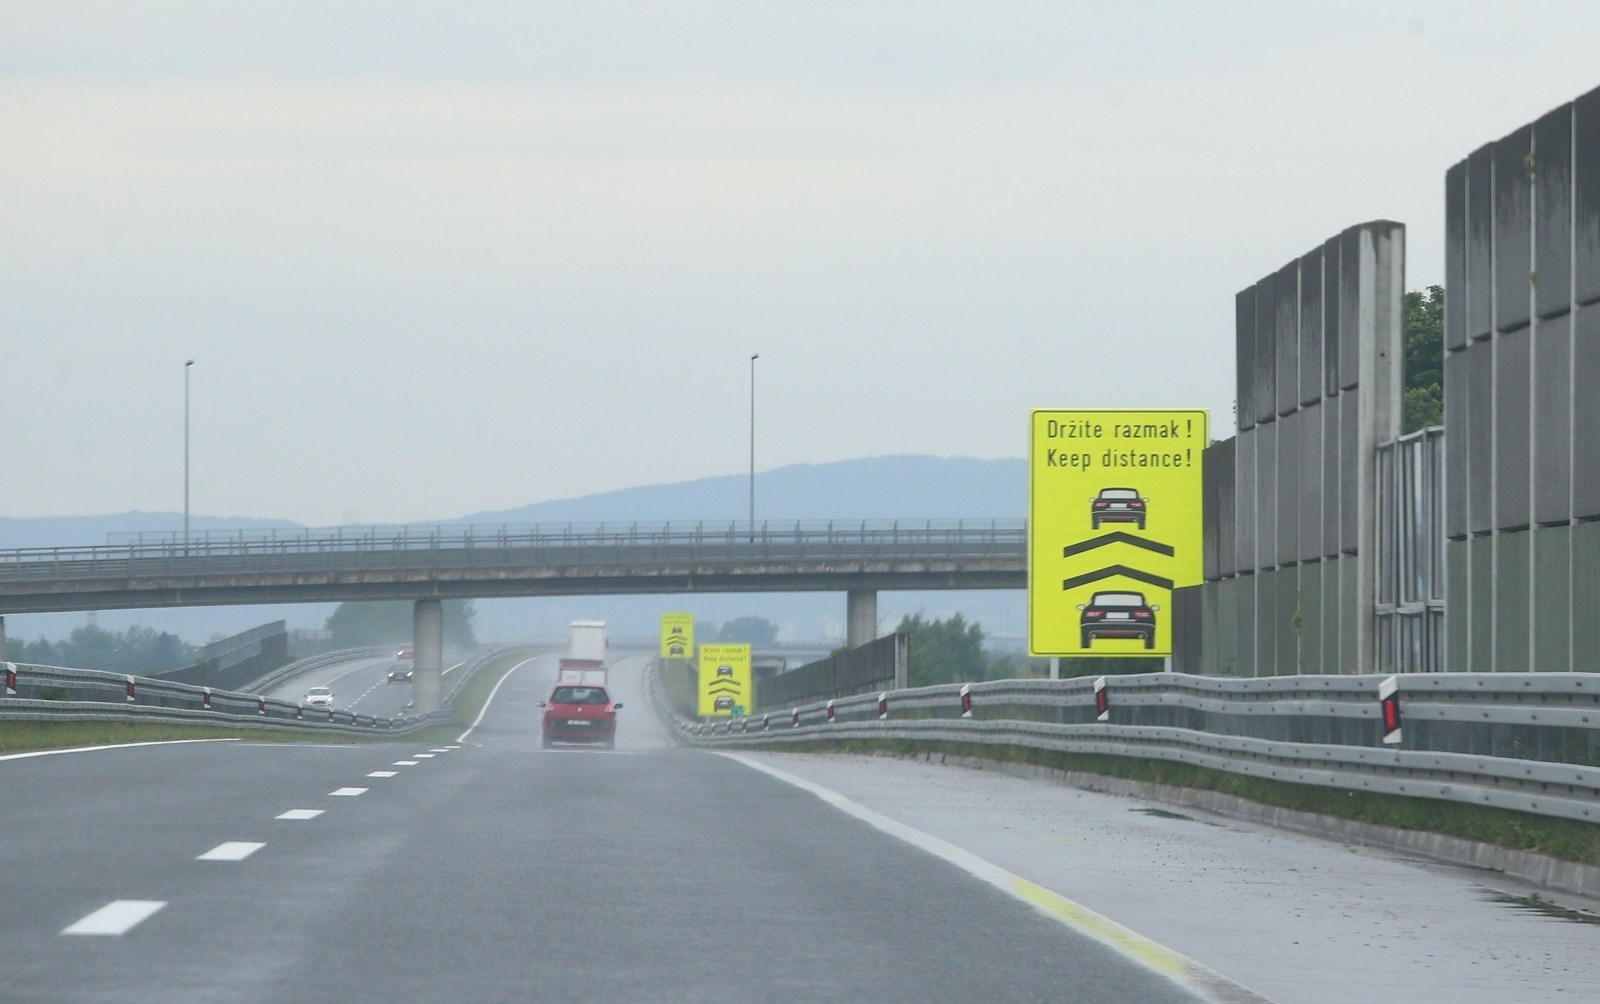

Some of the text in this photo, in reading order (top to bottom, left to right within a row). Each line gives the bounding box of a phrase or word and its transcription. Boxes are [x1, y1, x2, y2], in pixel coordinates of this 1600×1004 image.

[1047, 420, 1103, 438] Držite
[1047, 449, 1192, 471] Keep distance!
